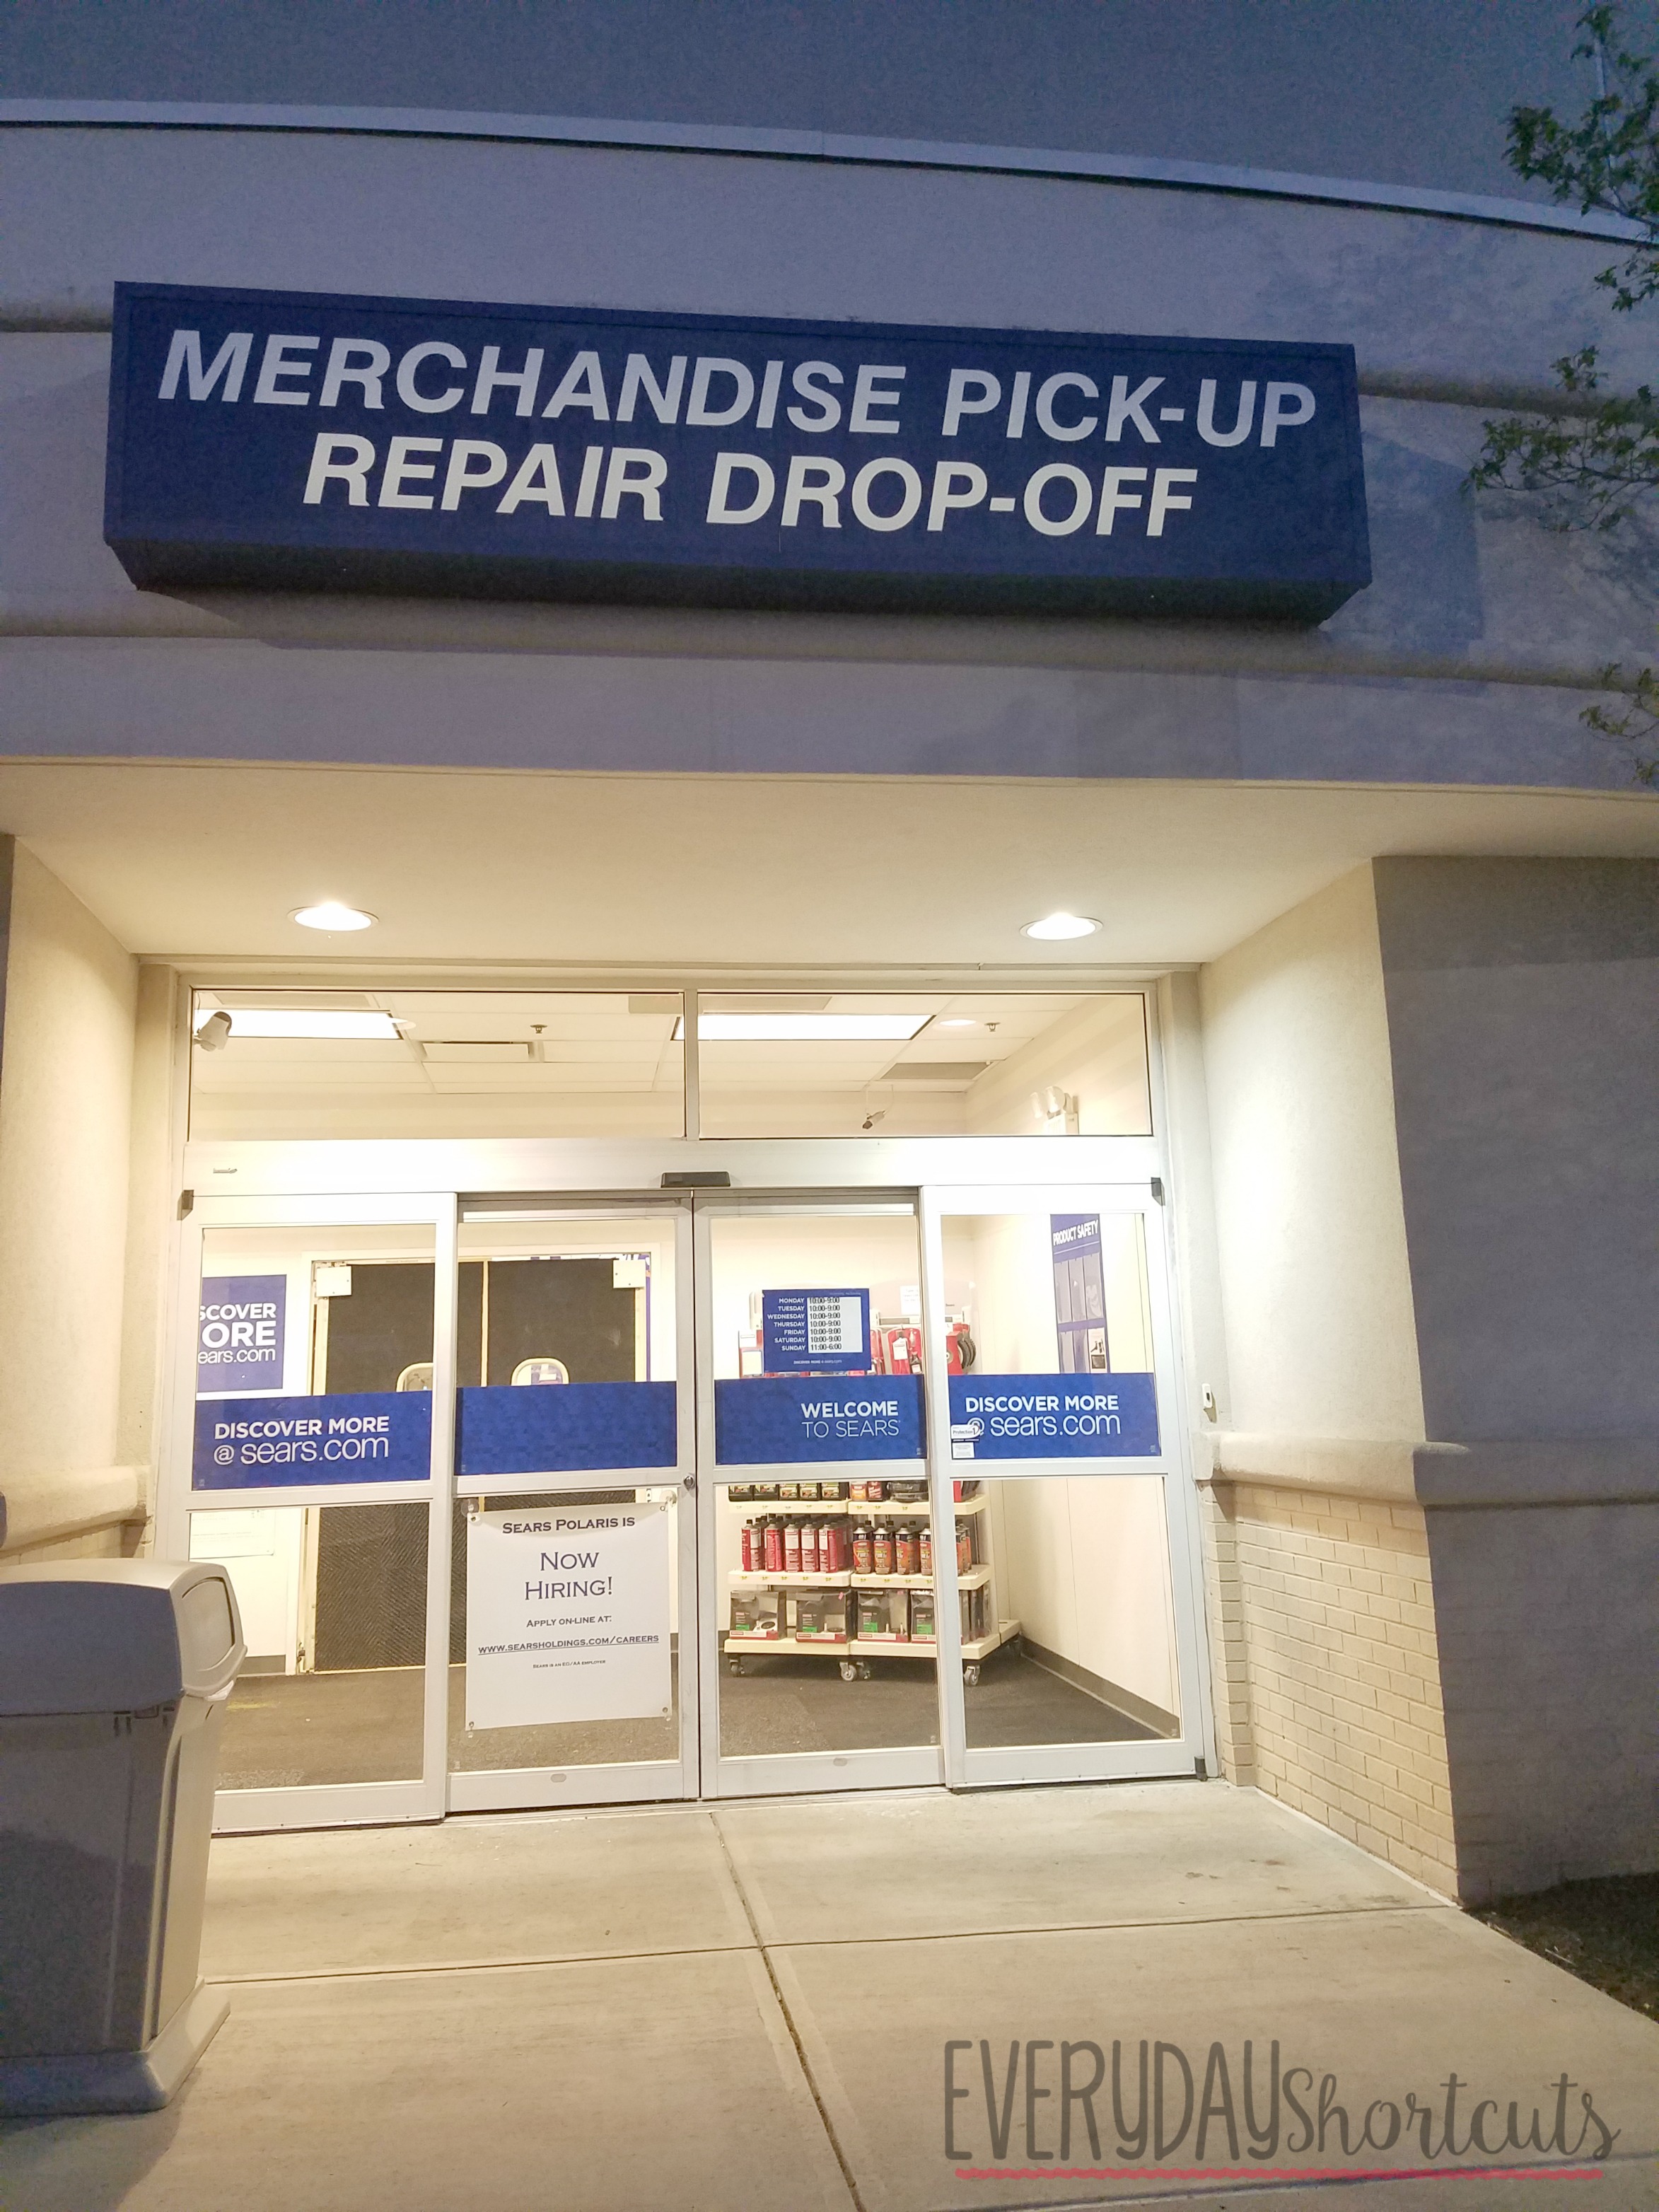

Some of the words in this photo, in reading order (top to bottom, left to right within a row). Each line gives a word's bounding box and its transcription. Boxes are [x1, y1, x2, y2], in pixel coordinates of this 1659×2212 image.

[158, 330, 907, 433] MERCHANDISE
[942, 368, 1316, 447] PICK-UP
[303, 433, 668, 521] REPAIR
[706, 452, 1198, 537] DROP-OFF
[1052, 1226, 1076, 1246] PRODUCT
[1077, 1219, 1099, 1239] SAFETY
[199, 1303, 276, 1321] SCOVER
[202, 1320, 276, 1349] ORE
[197, 1349, 276, 1364] ears.com
[801, 1401, 899, 1419] WELCOME
[965, 1395, 1059, 1413] DISCOVER
[1065, 1395, 1119, 1411] MORE
[214, 1419, 322, 1440] DISCOVER
[327, 1416, 390, 1435] MORE
[801, 1421, 830, 1438] TO
[835, 1419, 900, 1438] SEARS
[990, 1414, 1121, 1437] sears.com
[214, 1444, 235, 1465] @
[240, 1436, 390, 1465] sears.com
[502, 1522, 552, 1534] SEARS
[555, 1518, 619, 1531] POLARIS
[622, 1517, 636, 1527] IS
[540, 1552, 600, 1571] NOW
[525, 1576, 613, 1600] HIRING!
[526, 1619, 557, 1628] APPLY
[558, 1616, 595, 1625] ON-LINE
